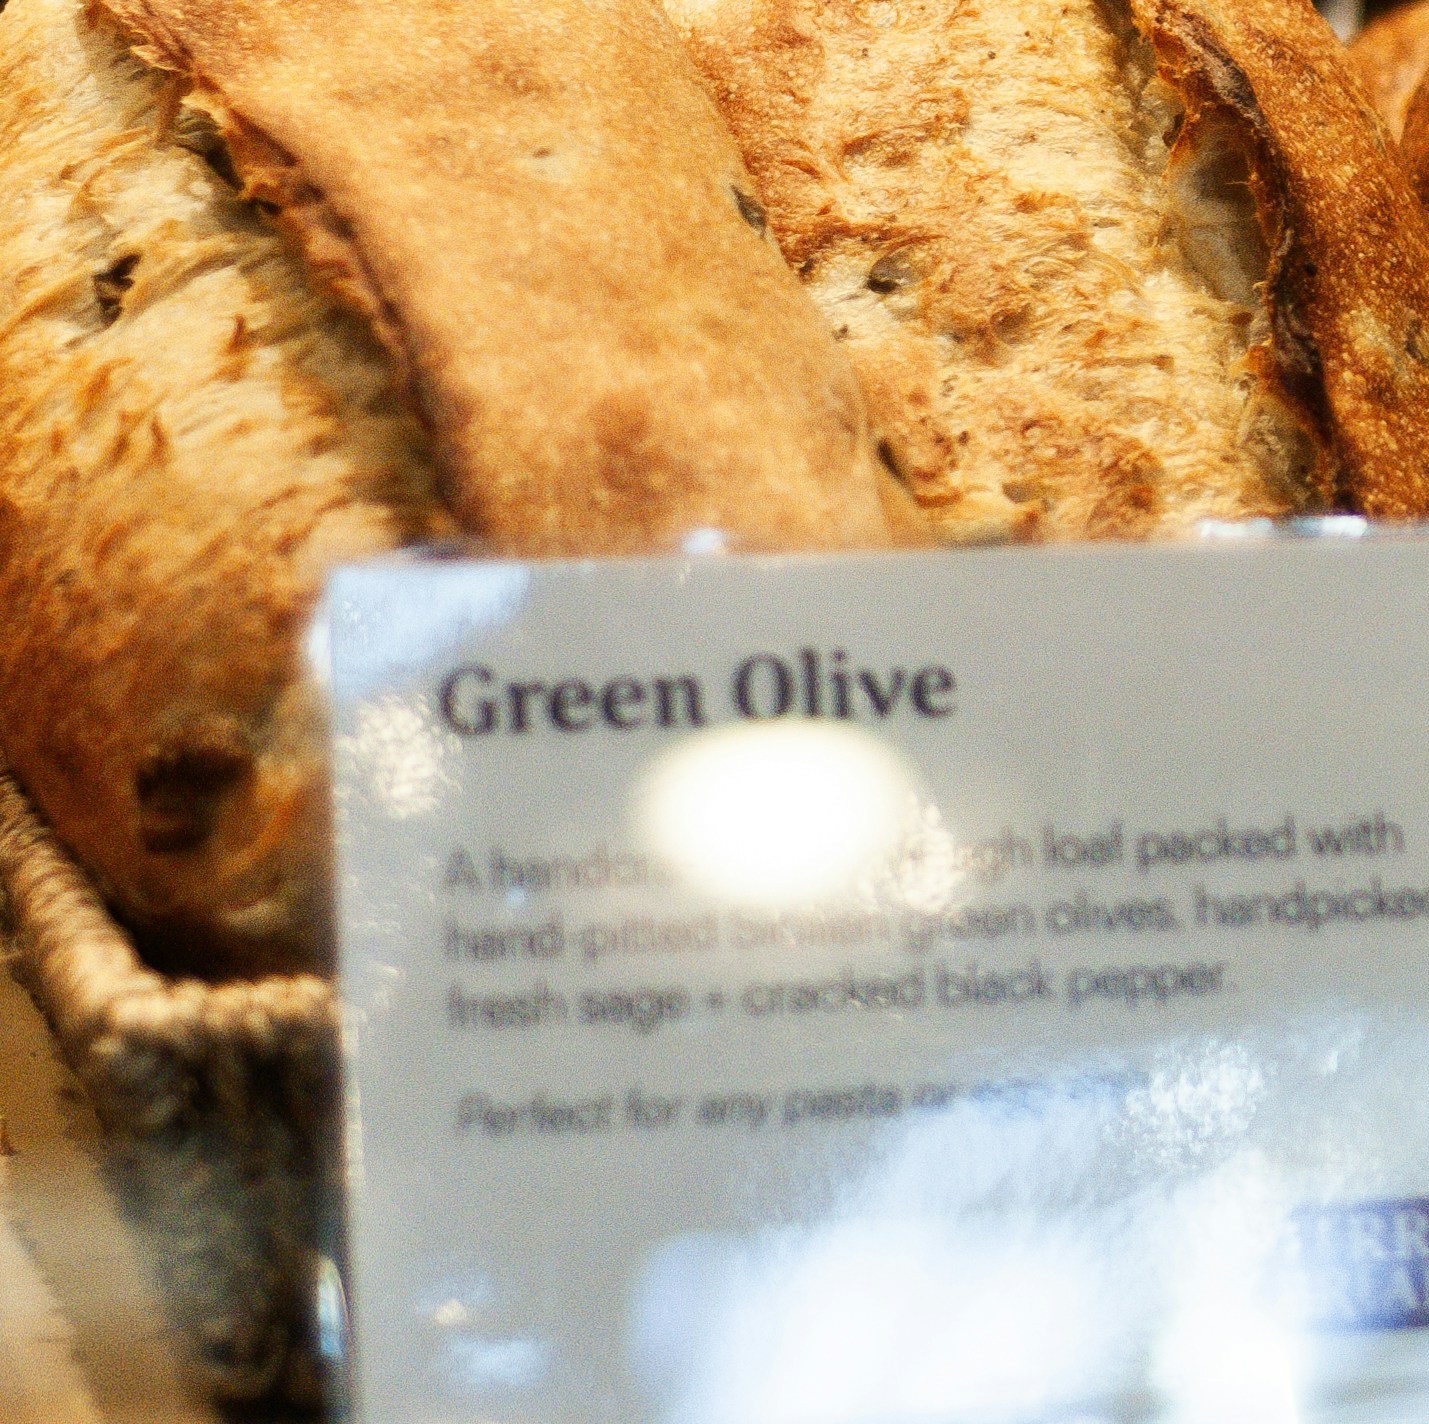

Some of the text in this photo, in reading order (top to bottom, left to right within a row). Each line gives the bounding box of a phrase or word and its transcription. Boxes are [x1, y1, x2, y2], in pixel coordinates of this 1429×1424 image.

[439, 647, 957, 738] Green Olive
[447, 848, 478, 890] A
[1041, 817, 1124, 870] loaf
[1134, 812, 1298, 876] packed
[1307, 806, 1406, 862] with
[445, 980, 567, 1028] fresh
[576, 983, 692, 1037] sage
[739, 962, 925, 1018] cracked
[935, 956, 1052, 1007] black
[456, 1089, 613, 1134] Perfect
[626, 1082, 683, 1128] for
[694, 1091, 771, 1130] any
[782, 1082, 900, 1125] pasta
